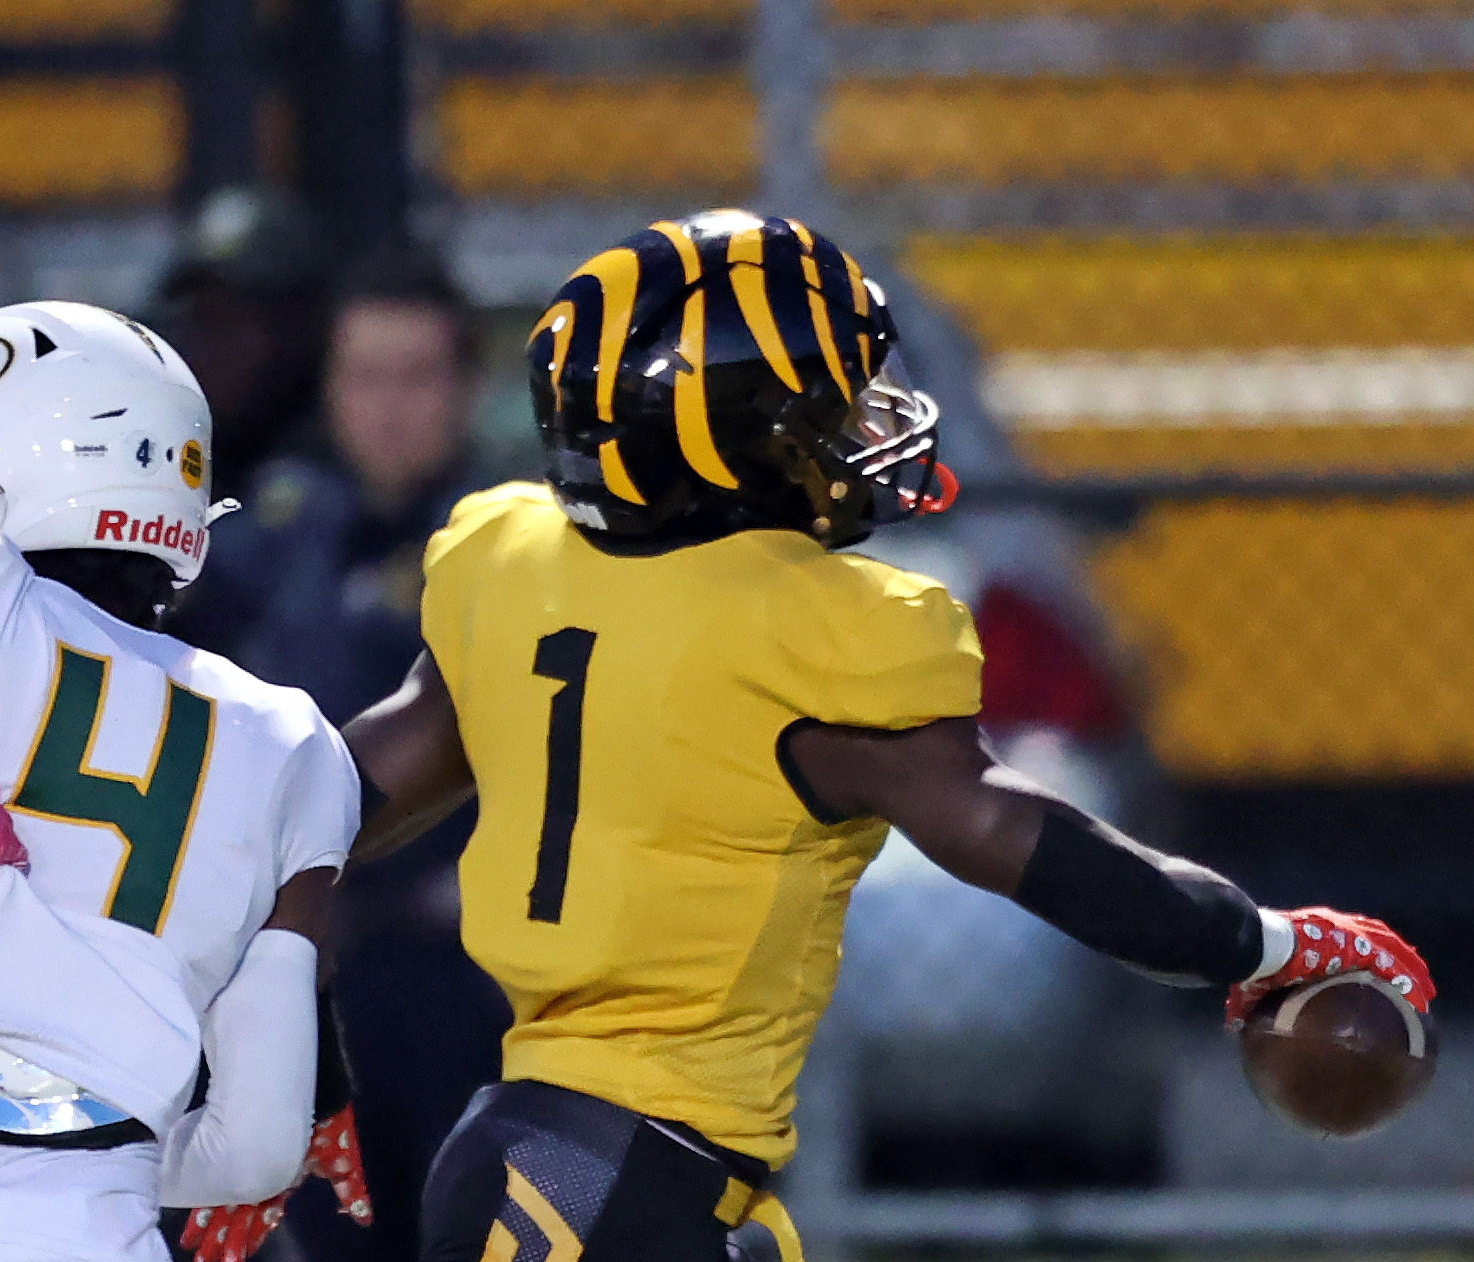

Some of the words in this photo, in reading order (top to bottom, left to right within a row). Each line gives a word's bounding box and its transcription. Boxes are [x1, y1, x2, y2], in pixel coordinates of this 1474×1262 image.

[94, 509, 205, 562] Riddell
[135, 438, 152, 468] 4
[4, 639, 217, 938] 4
[527, 627, 597, 925] 1
